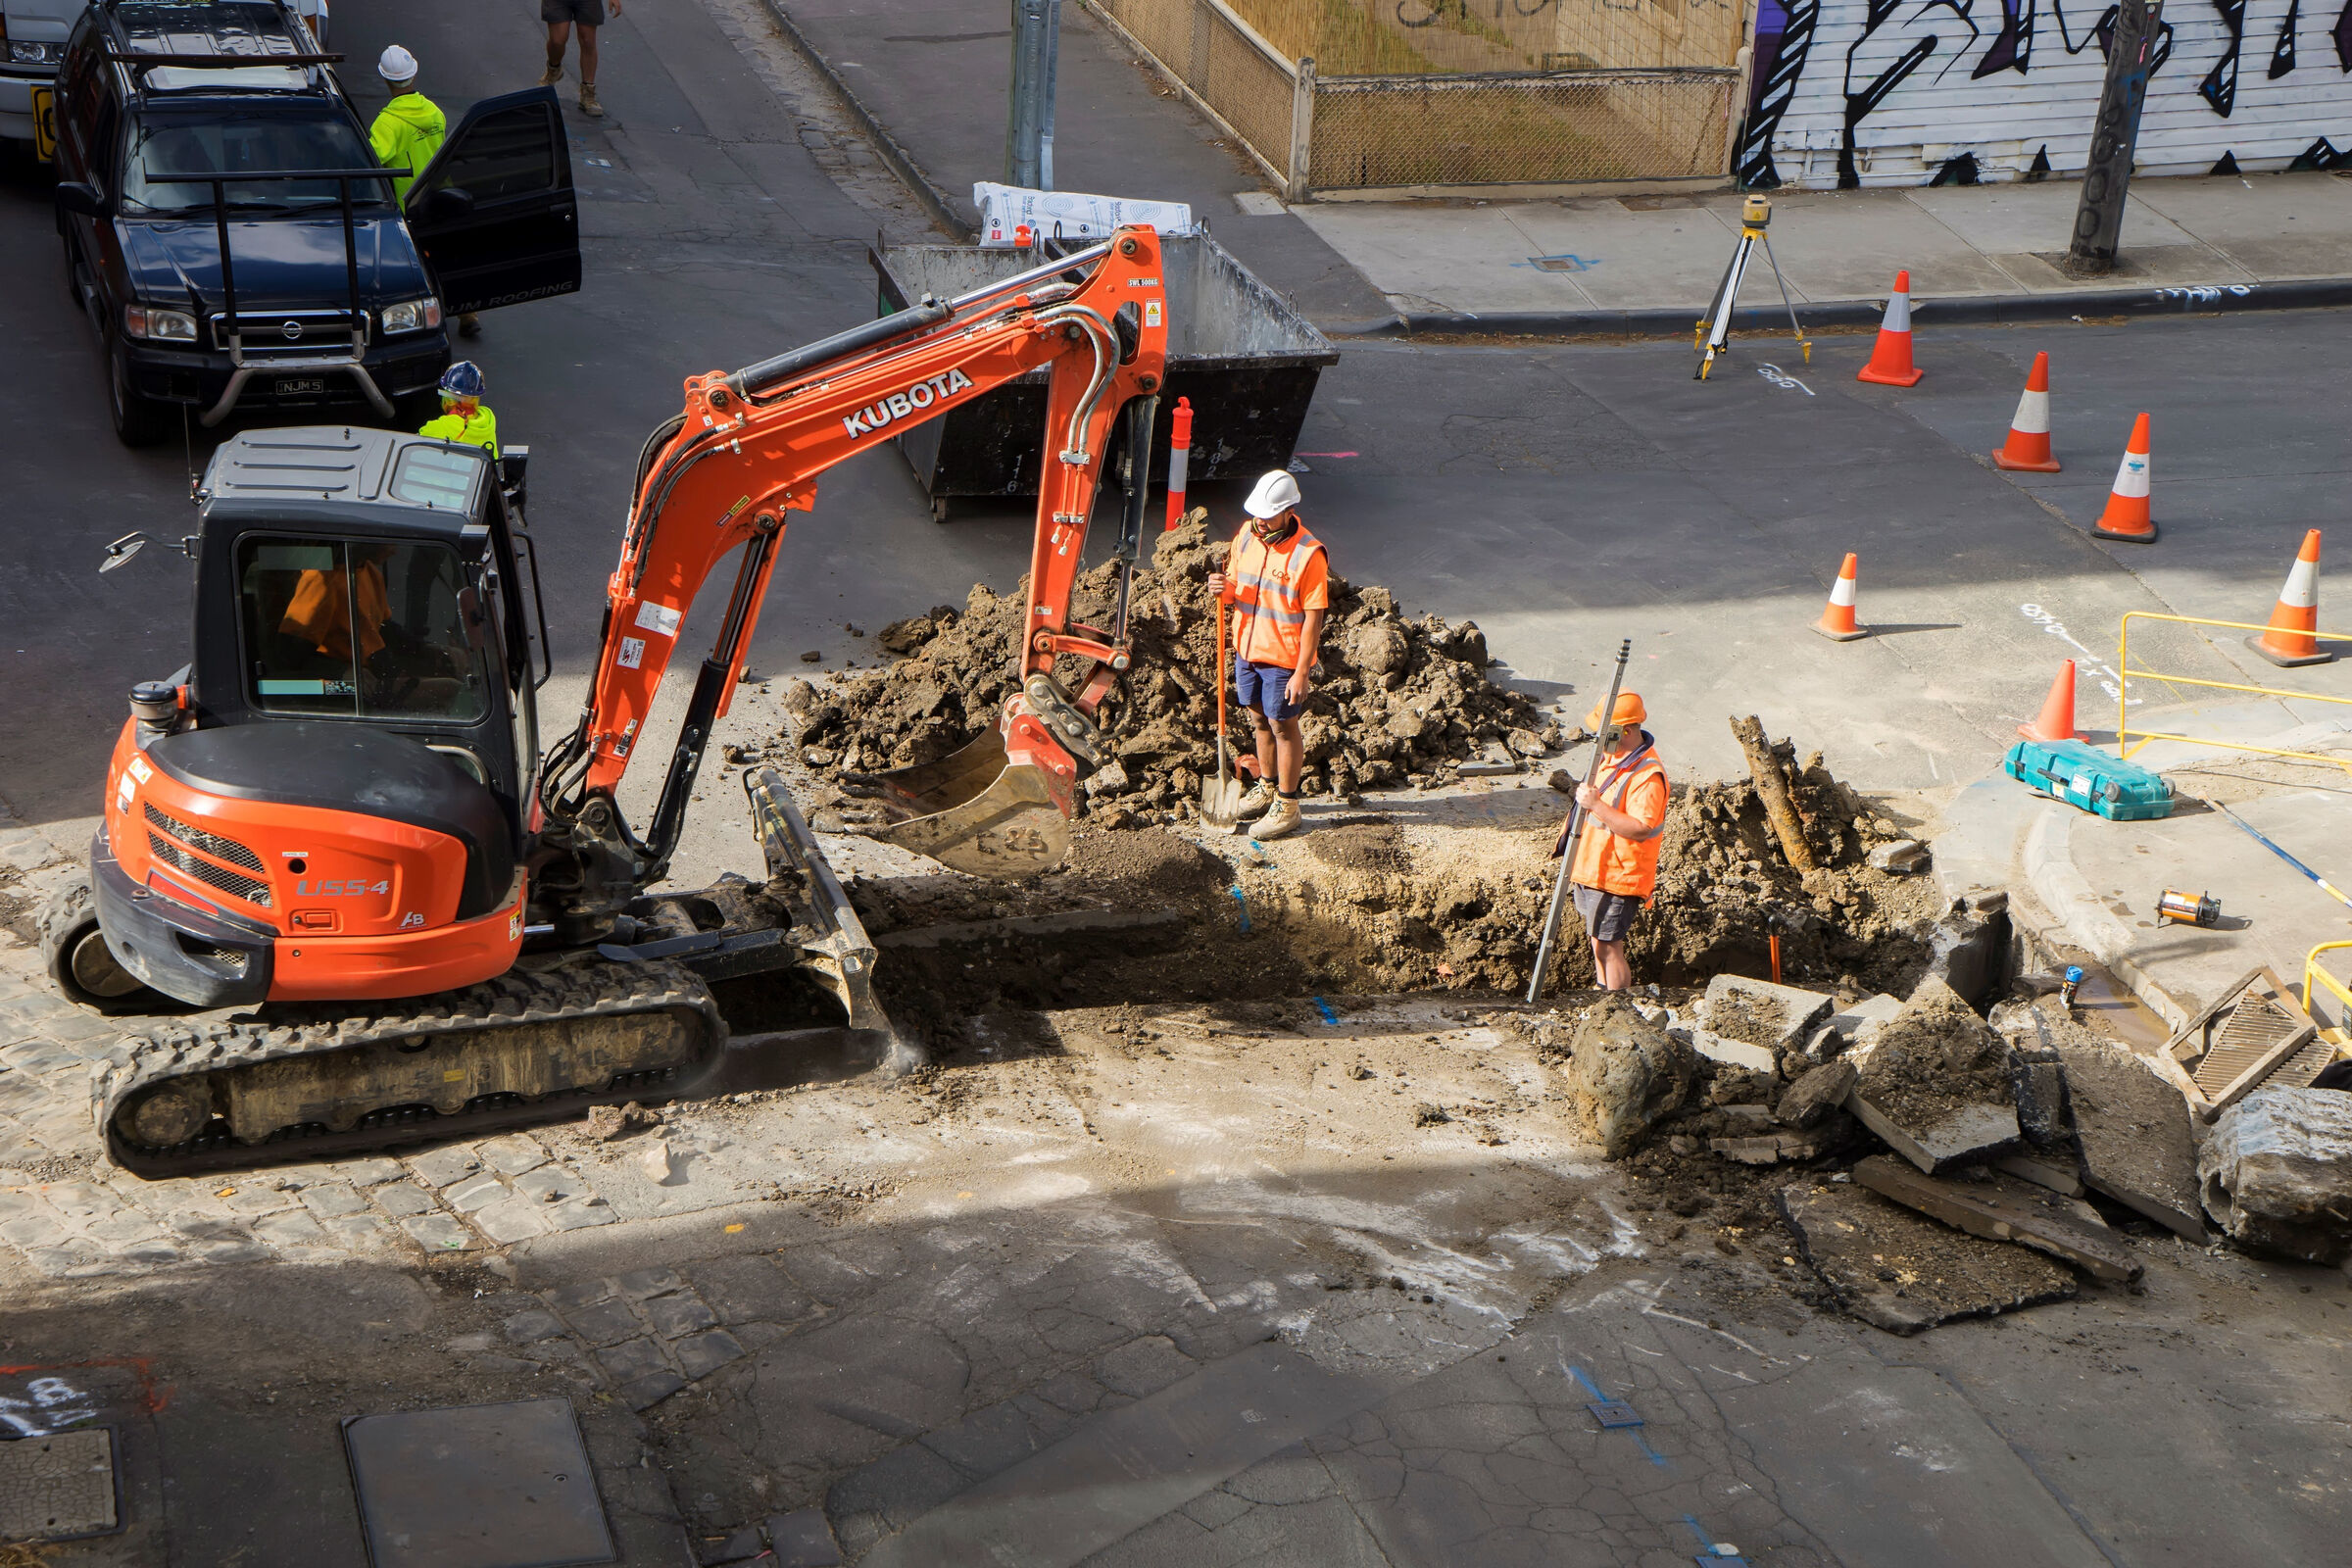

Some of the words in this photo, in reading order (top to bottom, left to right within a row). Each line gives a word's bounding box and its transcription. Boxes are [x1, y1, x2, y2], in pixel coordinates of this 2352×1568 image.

[490, 281, 573, 306] ROOFING
[1128, 278, 1140, 287] SWL
[842, 368, 973, 439] KUBOTA
